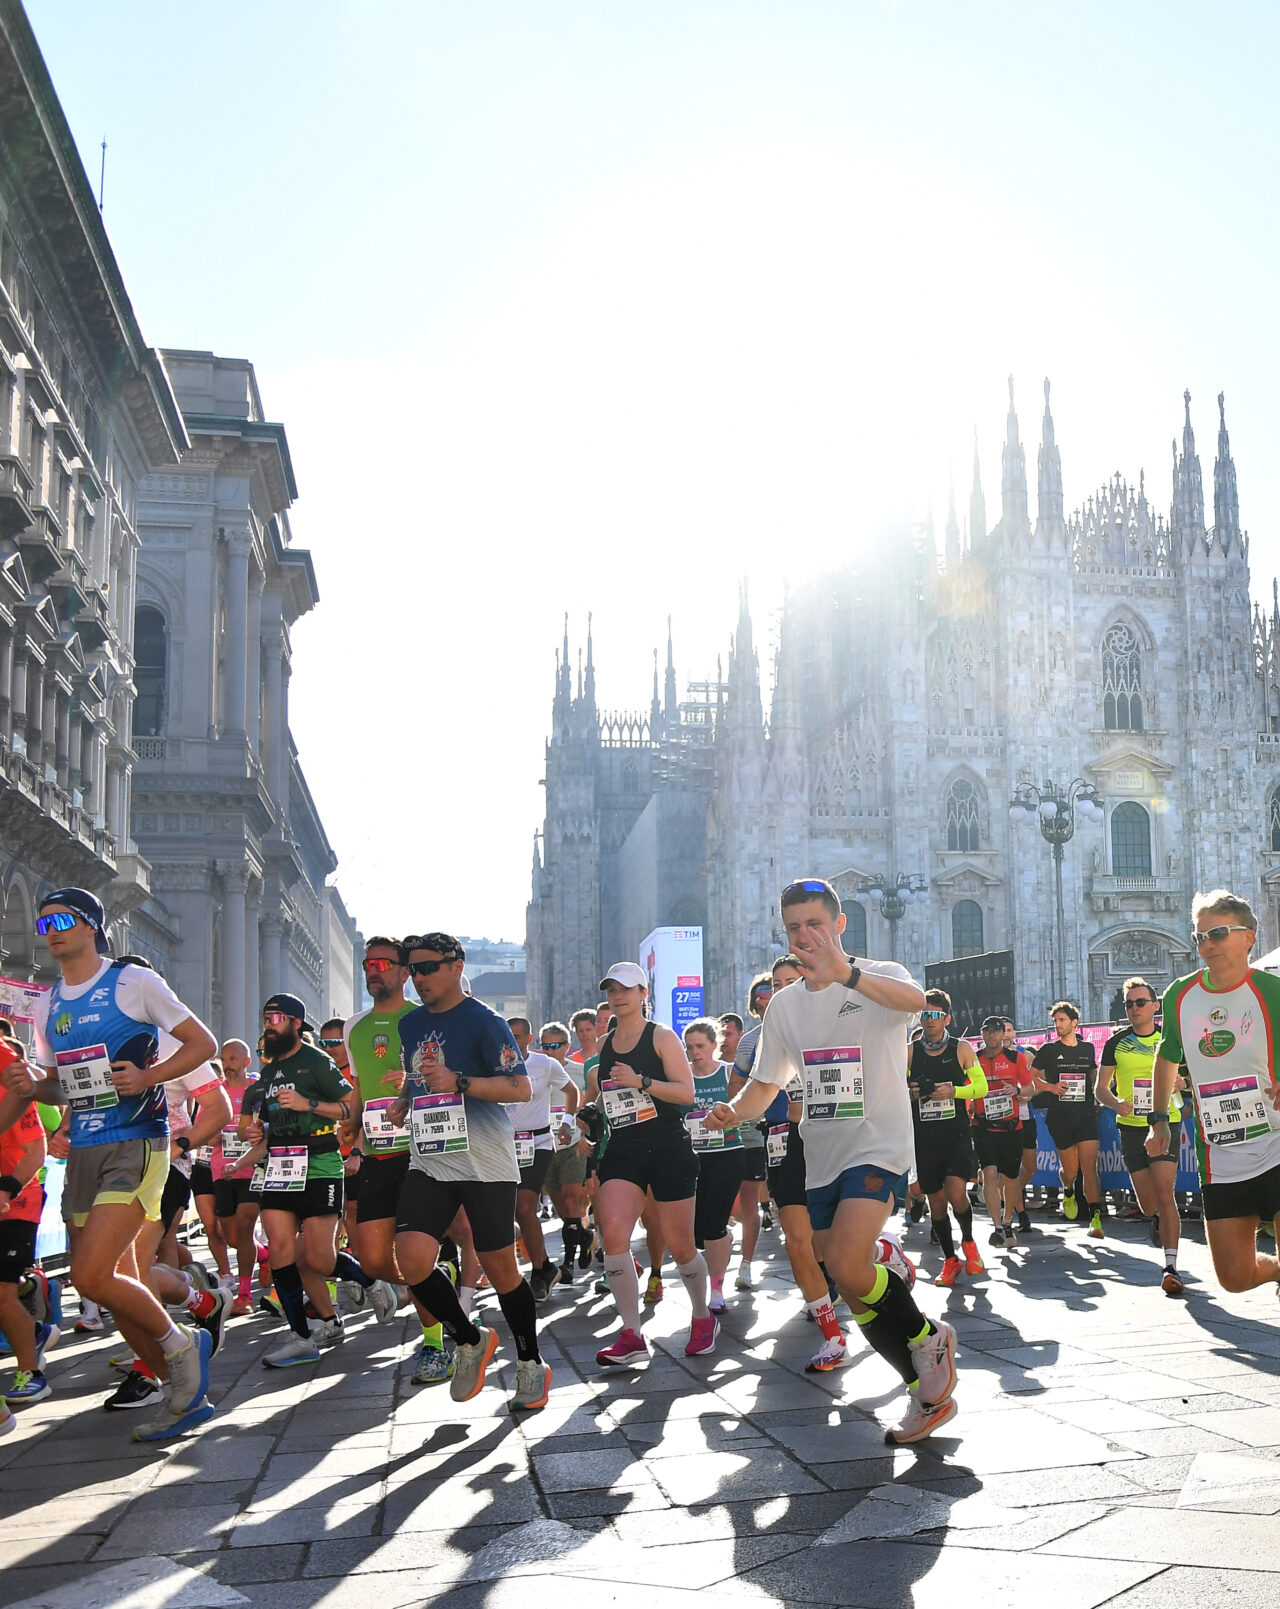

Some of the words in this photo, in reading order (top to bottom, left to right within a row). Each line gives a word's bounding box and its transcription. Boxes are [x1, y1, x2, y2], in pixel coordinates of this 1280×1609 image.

[684, 930, 700, 938] TIM
[819, 1068, 842, 1083] RICCARDO
[824, 1085, 836, 1095] 1189
[1219, 1098, 1242, 1113] STEFANO
[1226, 1113, 1241, 1124] 8711
